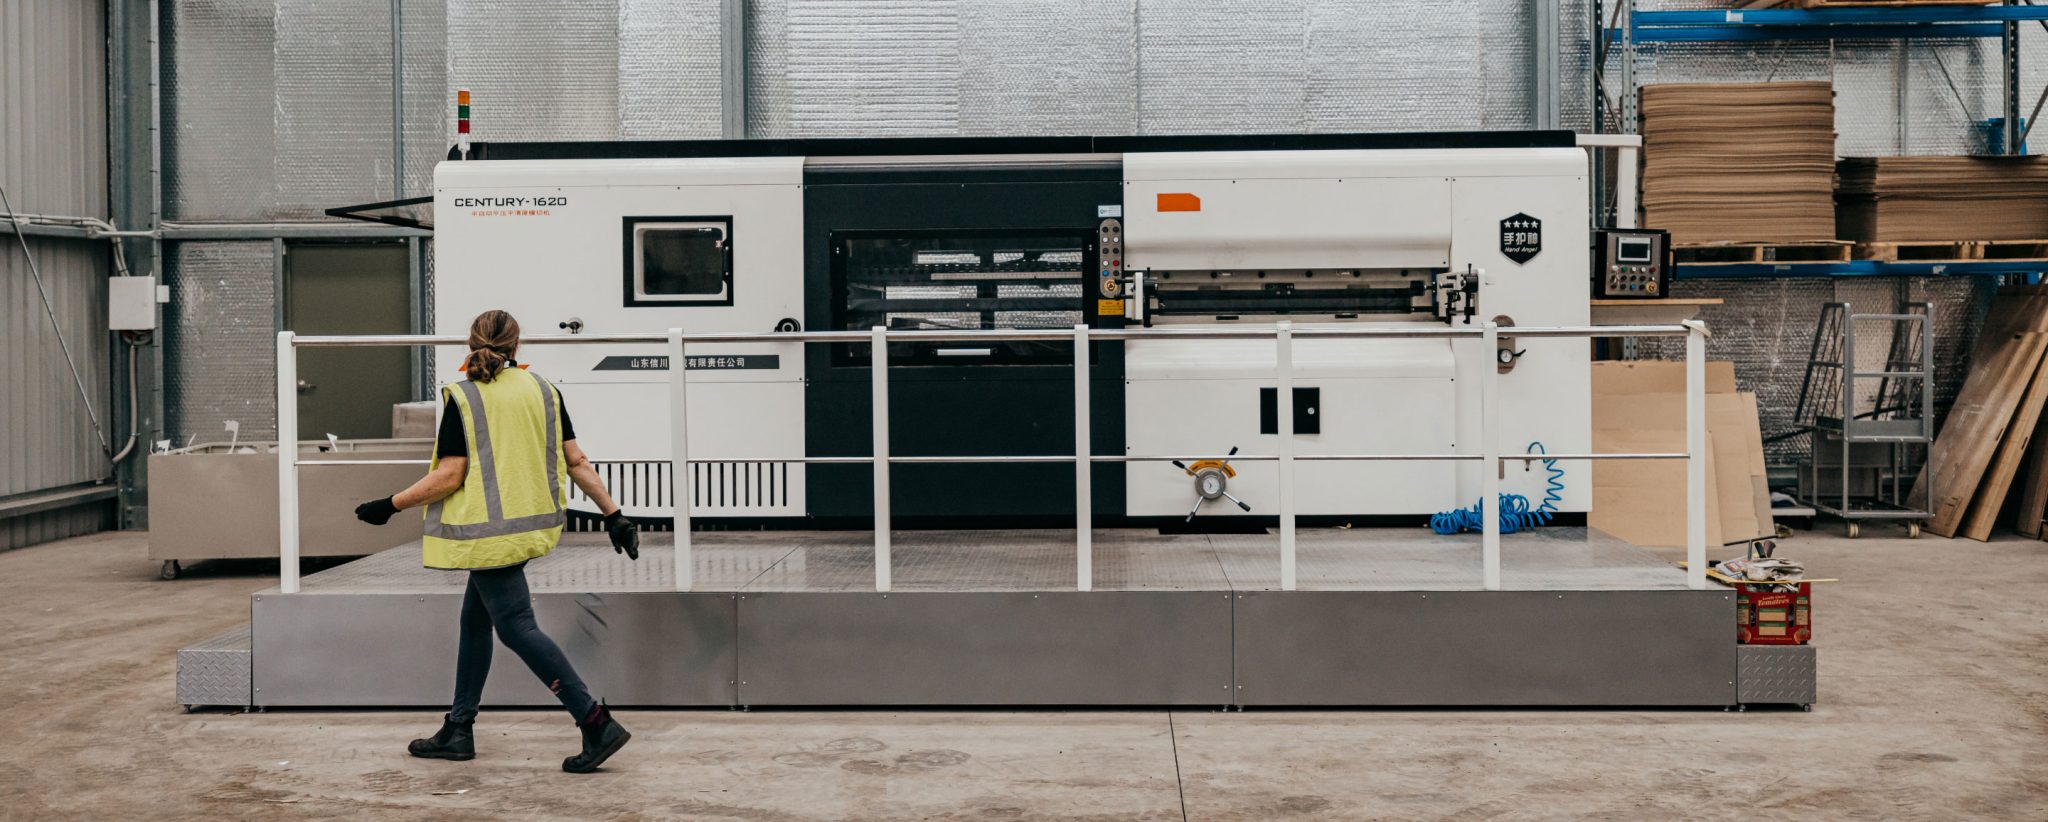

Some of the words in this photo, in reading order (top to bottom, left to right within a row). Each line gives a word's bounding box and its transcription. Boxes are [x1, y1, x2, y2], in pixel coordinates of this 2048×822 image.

[631, 357, 745, 368] 山东信川有限责任公司
